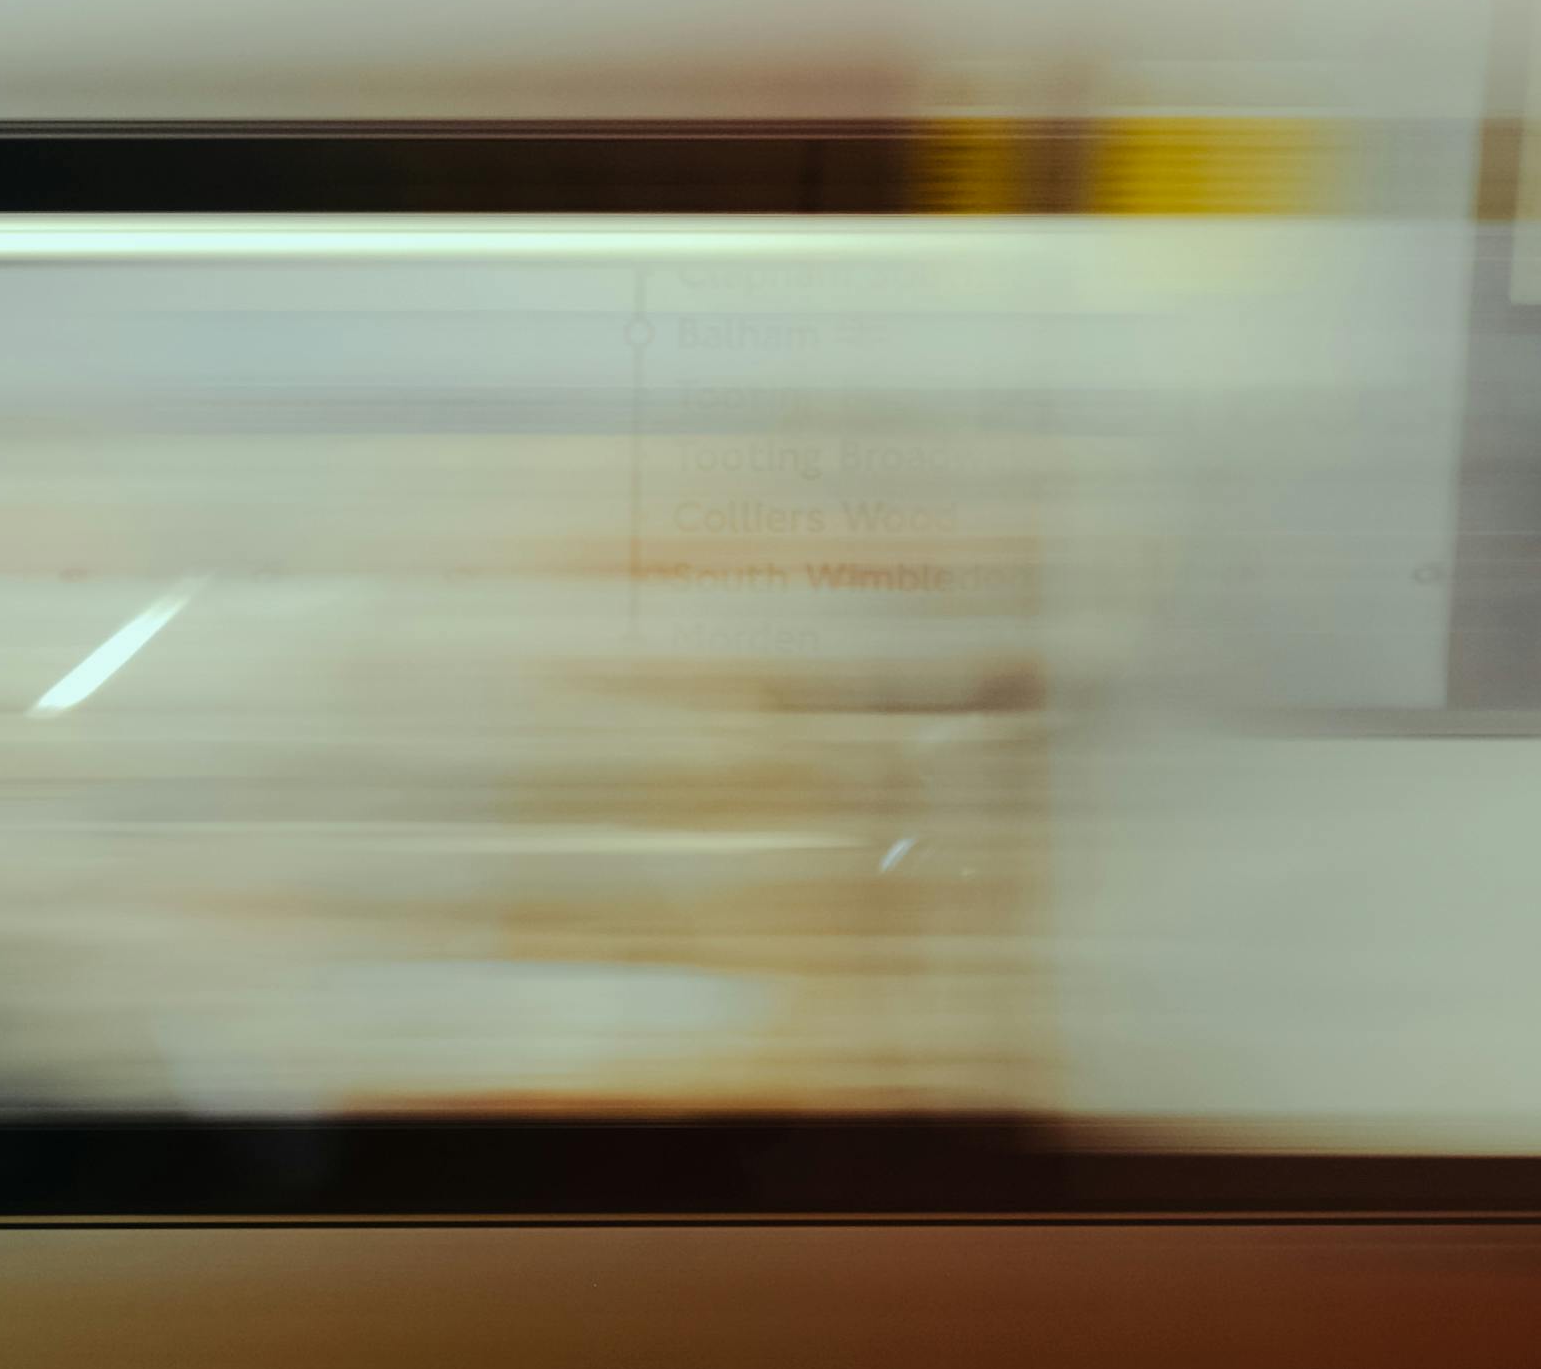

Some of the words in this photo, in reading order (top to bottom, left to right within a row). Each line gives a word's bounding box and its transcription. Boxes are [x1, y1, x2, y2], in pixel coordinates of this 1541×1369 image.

[672, 498, 826, 535] Colliers
[834, 498, 959, 535] Wood
[671, 559, 789, 595] South
